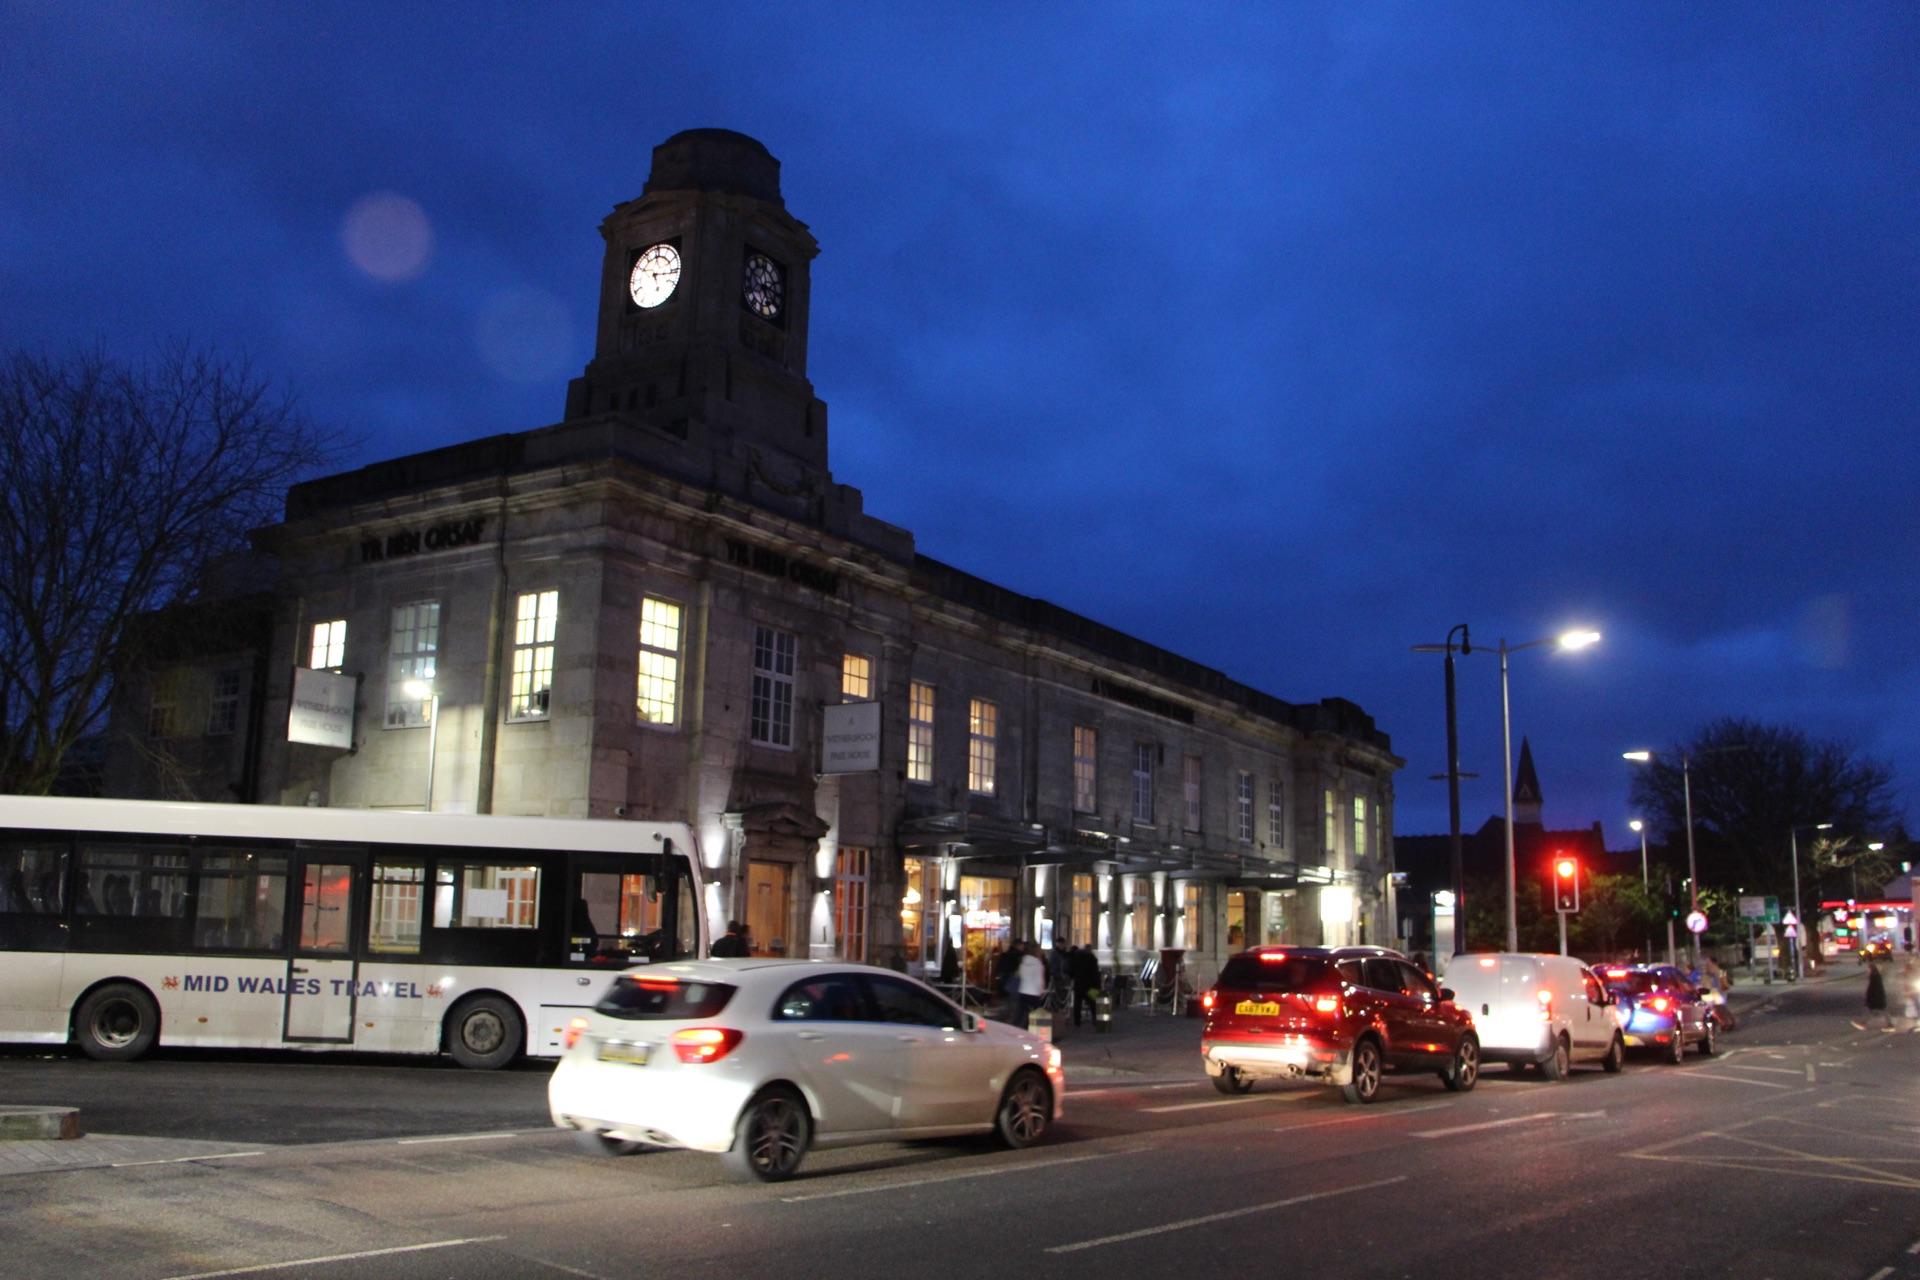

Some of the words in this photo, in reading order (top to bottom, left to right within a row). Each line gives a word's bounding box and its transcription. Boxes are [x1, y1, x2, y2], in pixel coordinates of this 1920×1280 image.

[361, 536, 384, 562] YR
[386, 528, 421, 558] HEN
[425, 516, 486, 551] ORSAF
[183, 974, 230, 993] MID
[237, 976, 321, 996] WALES
[330, 979, 423, 998] TRAVEL
